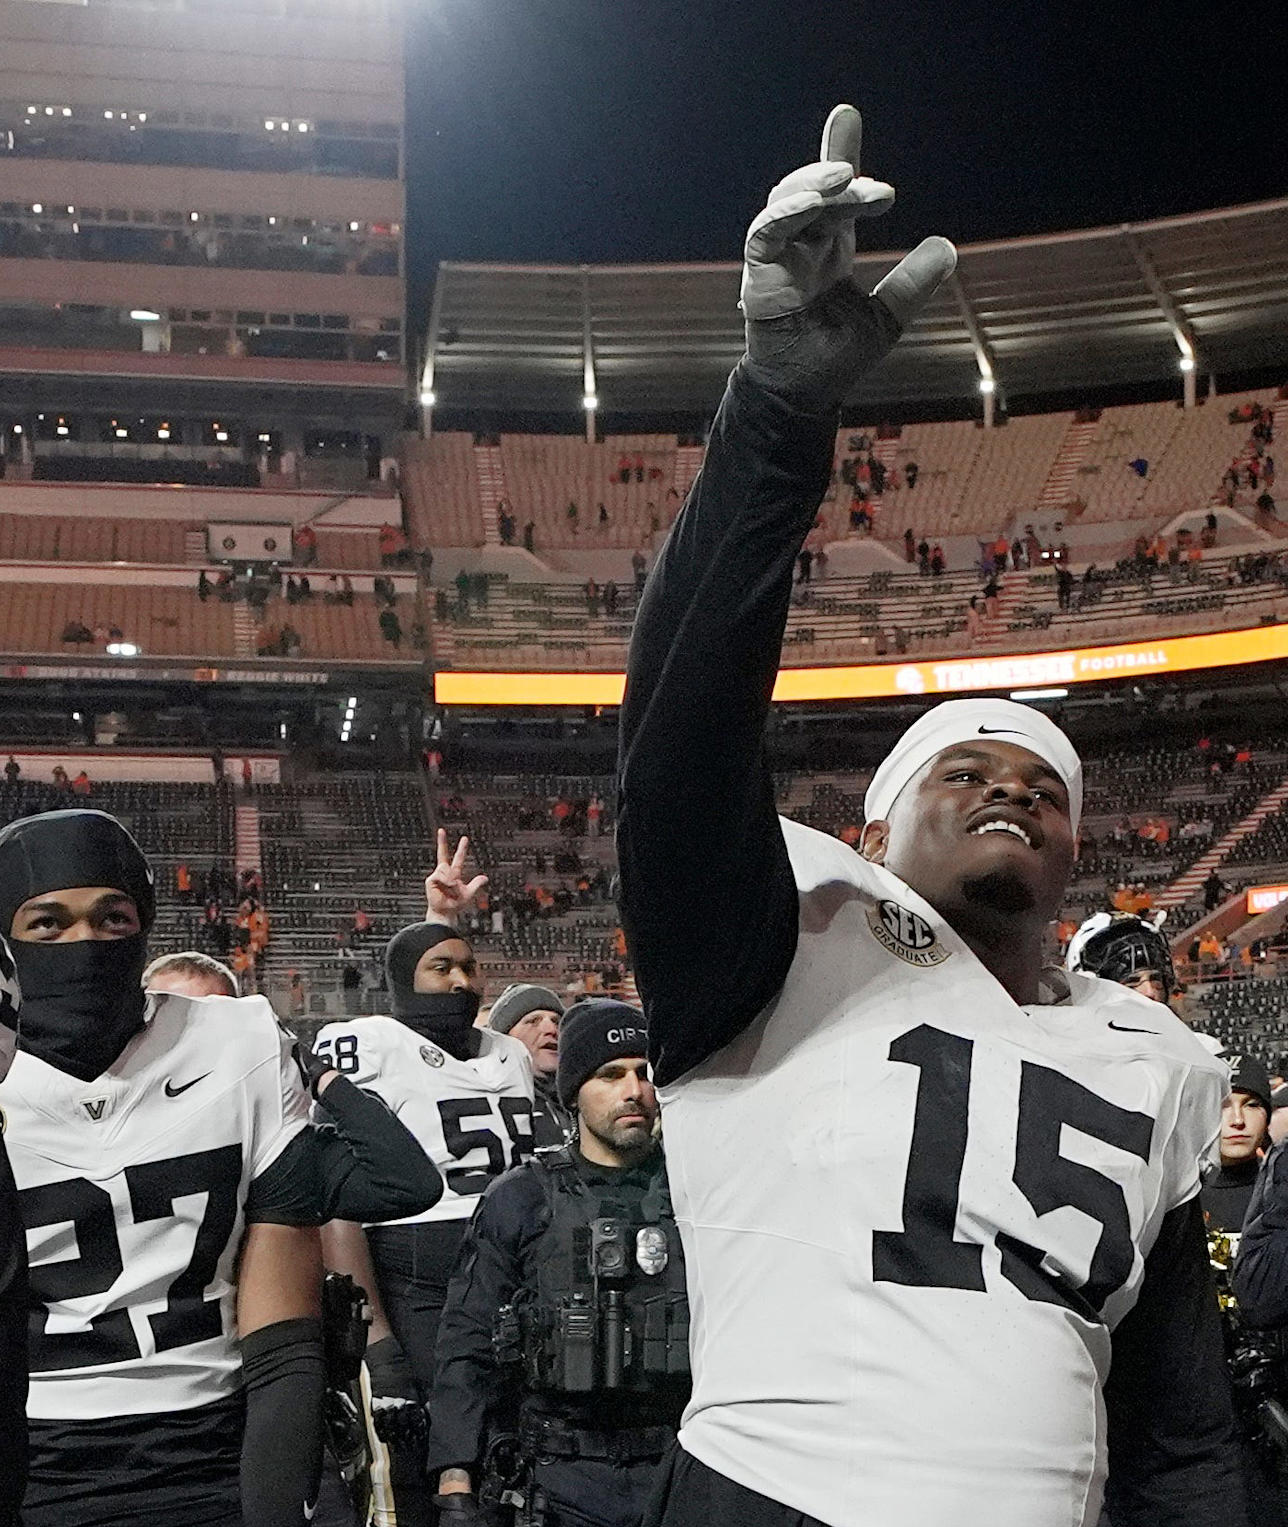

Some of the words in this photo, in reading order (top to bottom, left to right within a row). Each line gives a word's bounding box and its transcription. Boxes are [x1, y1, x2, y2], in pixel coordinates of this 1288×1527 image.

[933, 654, 1075, 690] TENNESSEE
[1080, 650, 1168, 672] FOOTBALL
[874, 925, 938, 964] GRADUATE
[882, 902, 932, 948] SEC
[873, 1023, 1155, 1325] 15
[17, 1142, 243, 1374] 27
